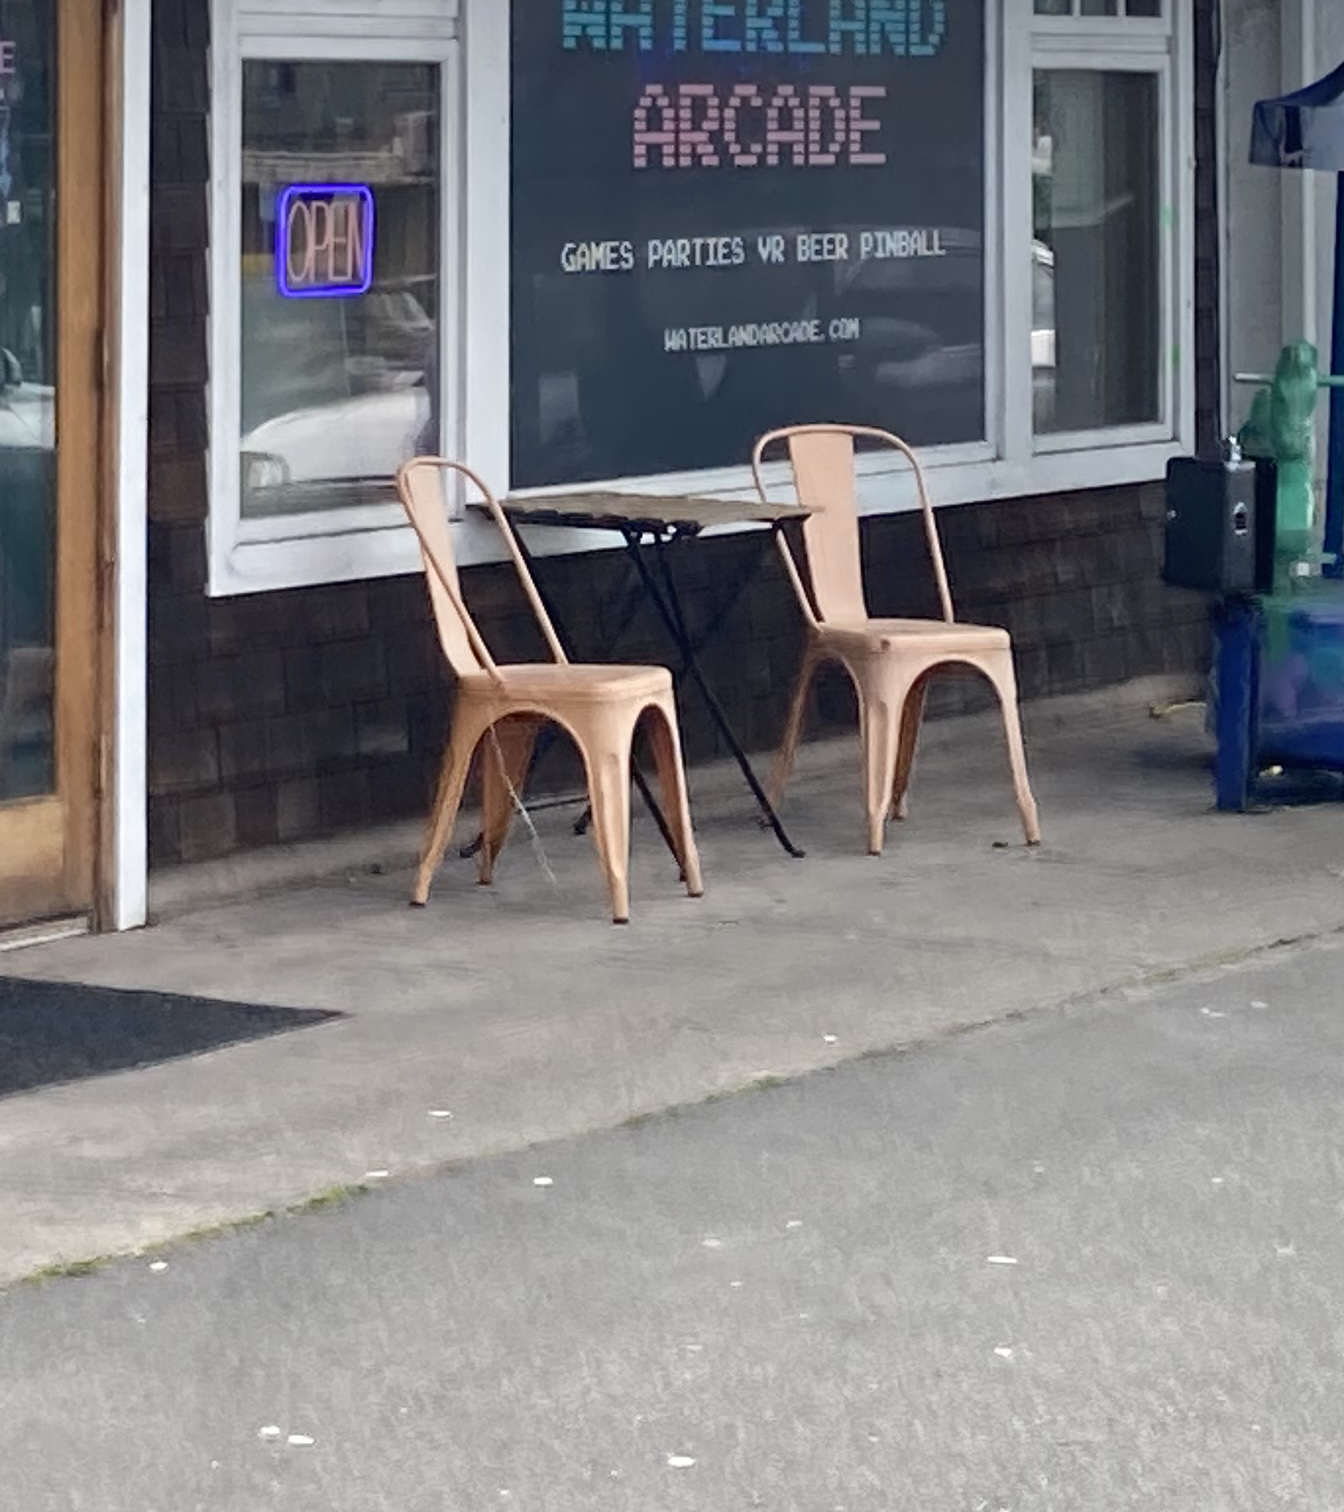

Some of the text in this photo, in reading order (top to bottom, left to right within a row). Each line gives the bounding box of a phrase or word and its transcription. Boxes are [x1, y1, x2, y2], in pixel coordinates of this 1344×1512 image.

[633, 84, 888, 168] ARCADE
[286, 200, 369, 283] OPEN
[560, 229, 947, 273] GAMES PARTIES VR BEER PINBALL
[663, 316, 861, 353] WATERLANDARCADE.COM
